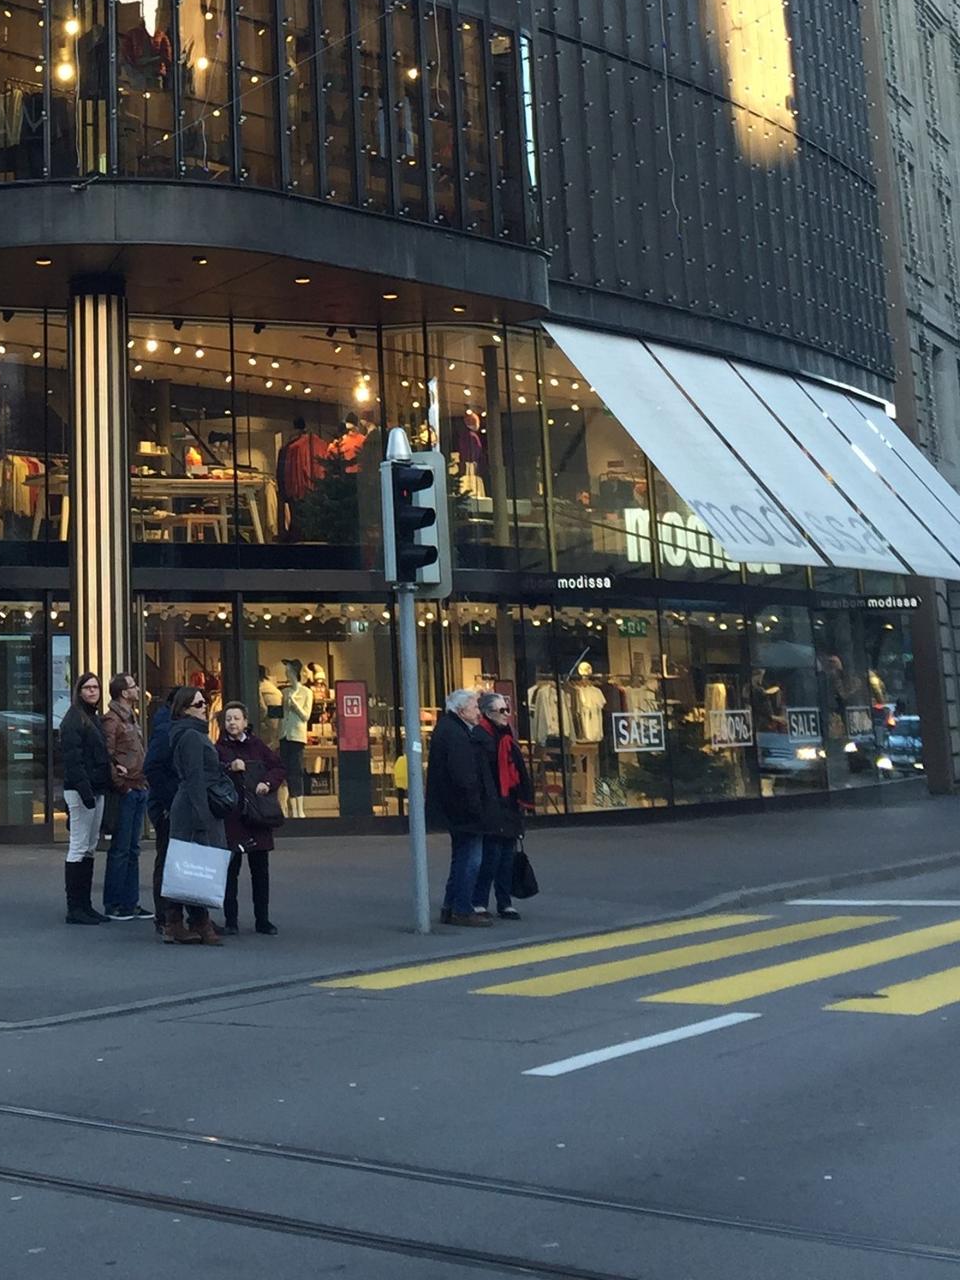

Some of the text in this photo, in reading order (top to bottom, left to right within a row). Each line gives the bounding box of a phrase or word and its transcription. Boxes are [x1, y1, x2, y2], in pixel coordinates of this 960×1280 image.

[557, 575, 612, 589] modissa
[867, 596, 918, 608] modissa
[618, 720, 660, 745] SALE
[790, 714, 818, 736] SALE
